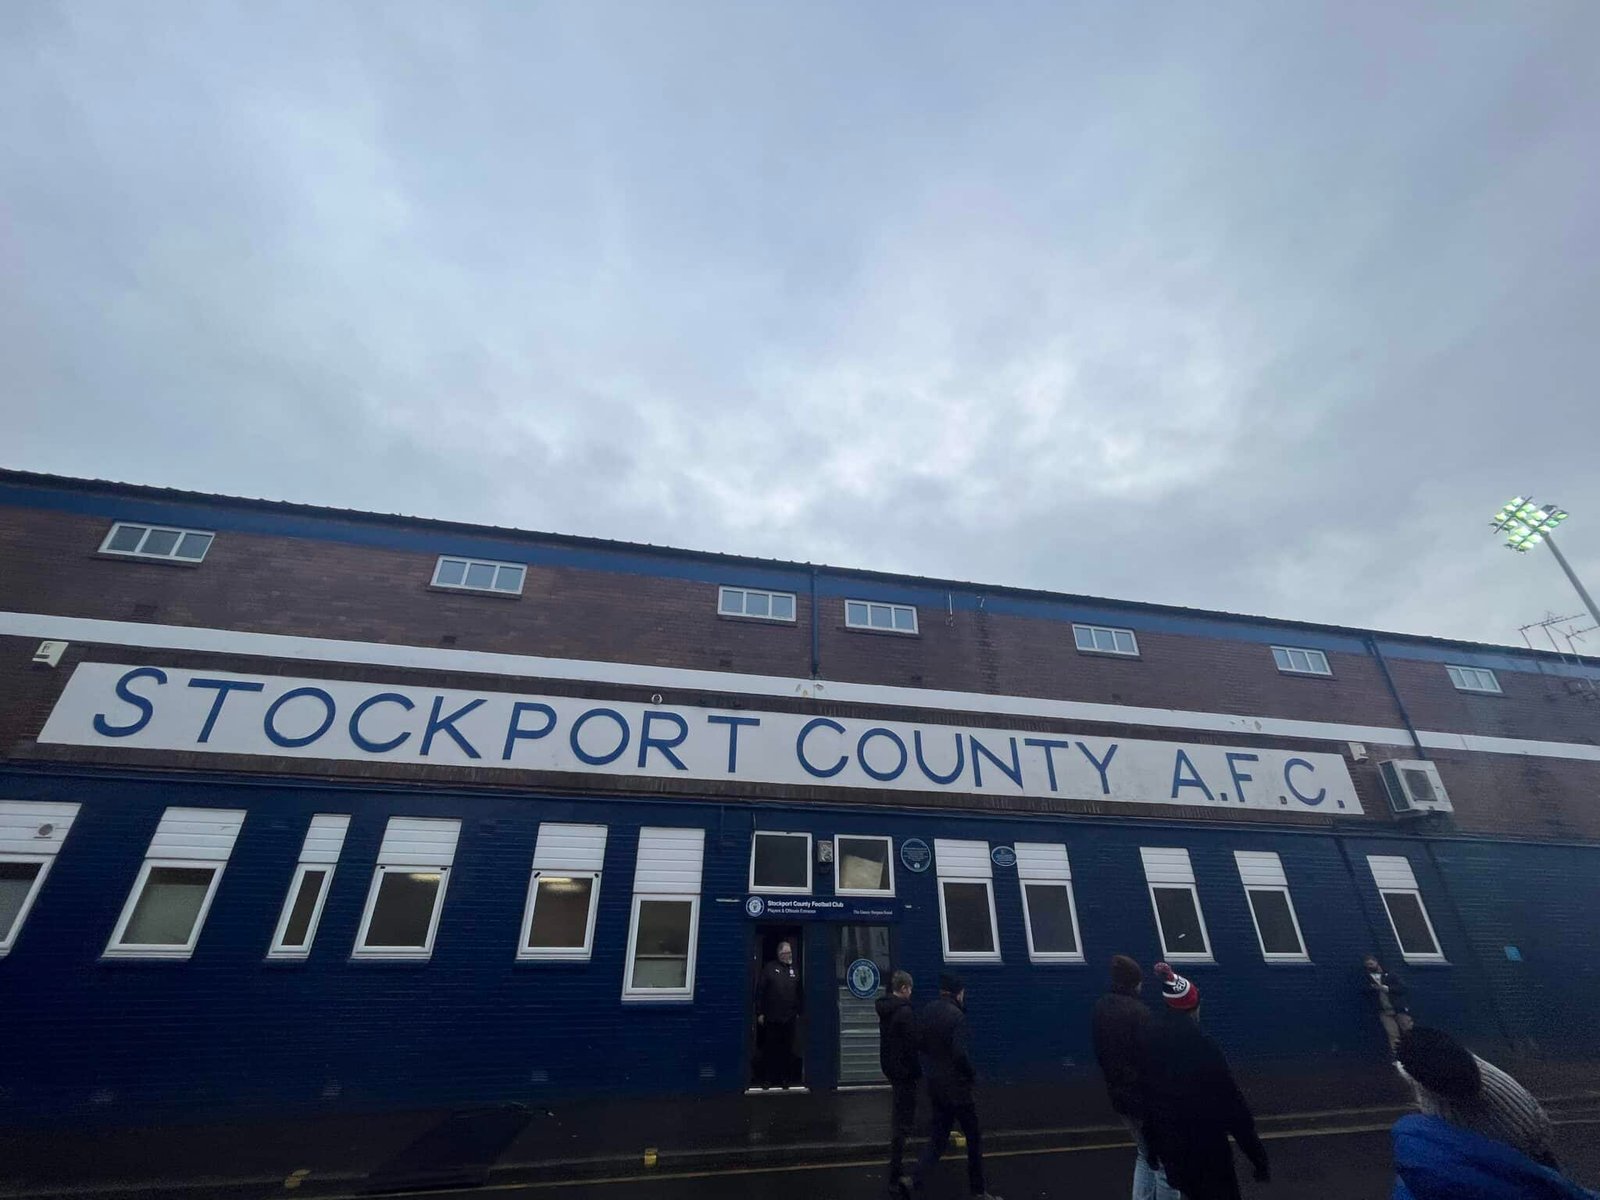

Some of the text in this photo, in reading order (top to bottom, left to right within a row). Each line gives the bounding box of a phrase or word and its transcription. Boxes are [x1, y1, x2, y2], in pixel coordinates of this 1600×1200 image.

[94, 667, 1345, 810] STOCKPORT COUNTY A.F.C.
[767, 900, 793, 908] Stockport
[793, 900, 811, 909] County
[811, 900, 832, 908] Football
